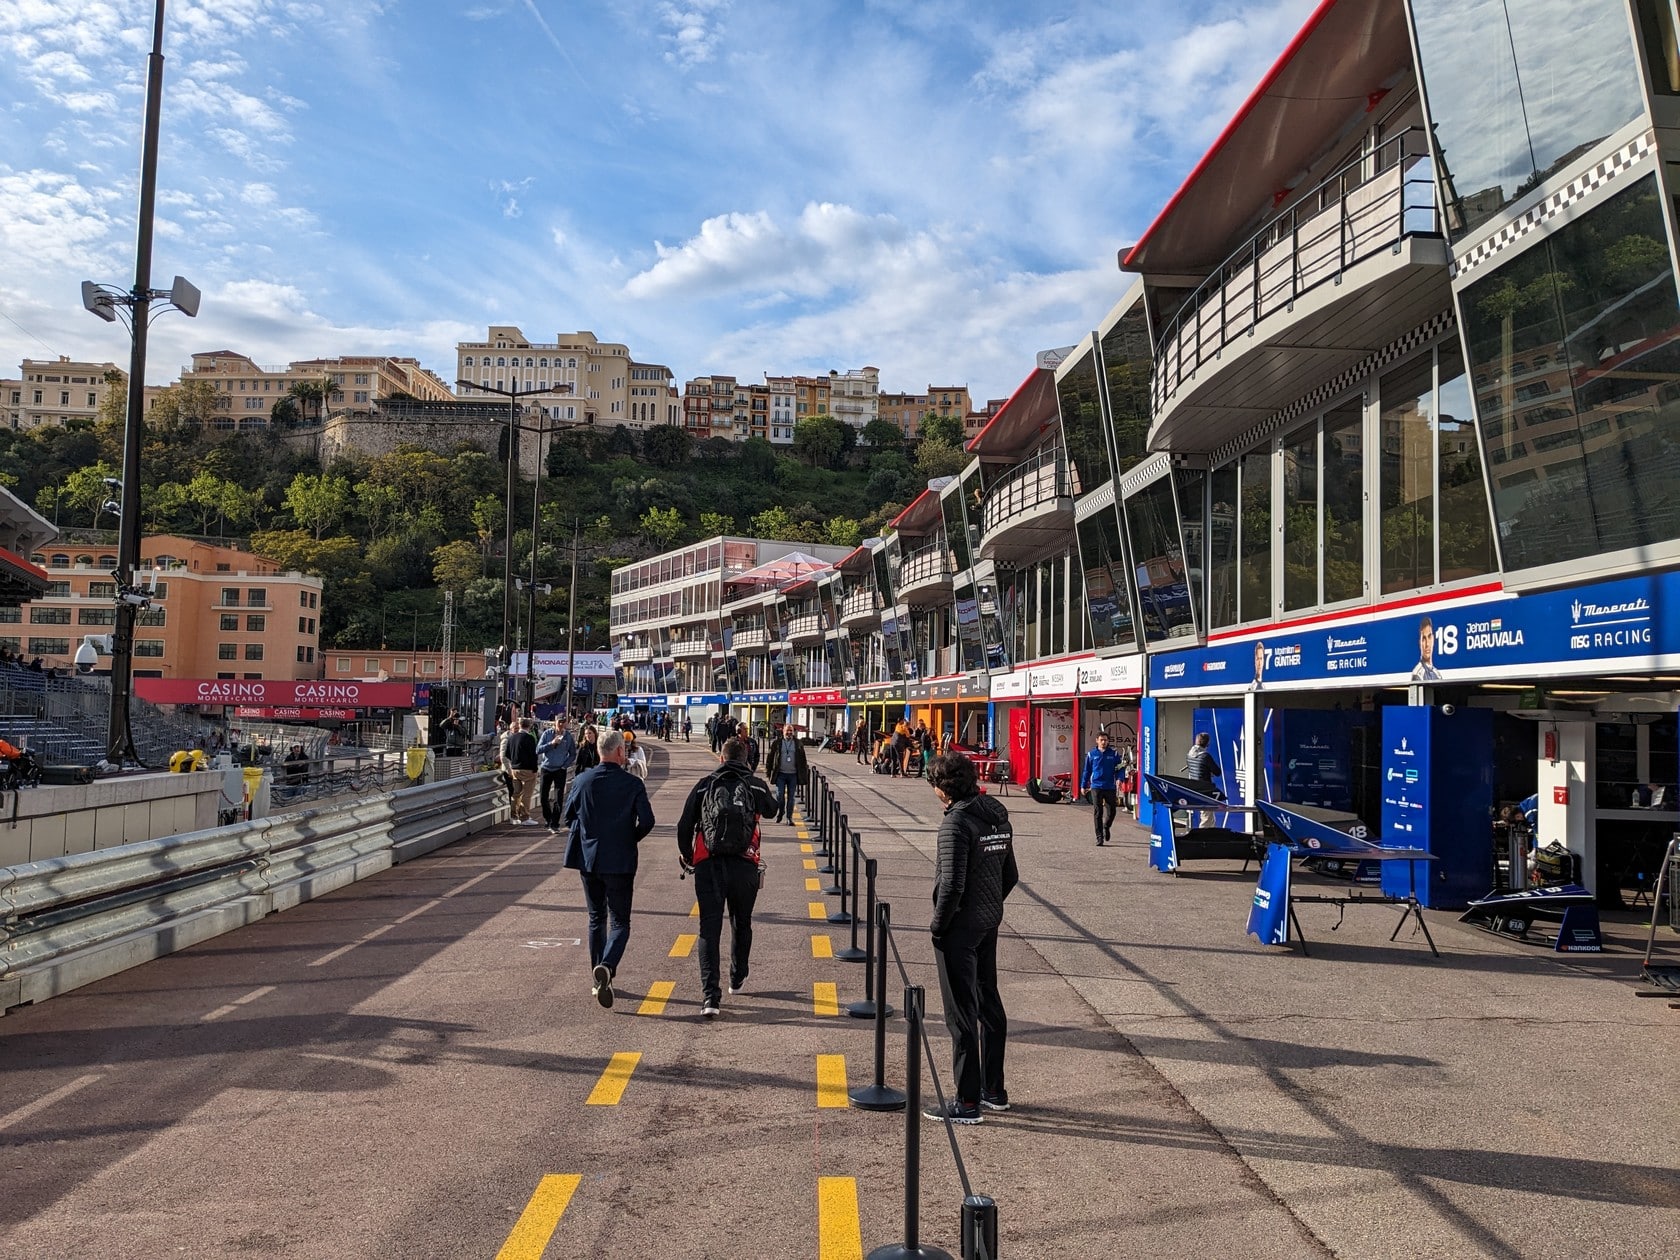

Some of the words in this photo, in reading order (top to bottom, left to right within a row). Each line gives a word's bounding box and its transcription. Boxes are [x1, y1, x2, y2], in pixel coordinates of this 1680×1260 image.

[1583, 598, 1650, 617] Maserati
[1466, 622, 1490, 634] Jehan
[1435, 624, 1458, 655] 18
[1466, 630, 1524, 650] DARUVALA
[1570, 634, 1590, 649] MSG
[1595, 628, 1651, 647] RACING
[1265, 648, 1273, 670] 7
[1339, 657, 1367, 669] RACING
[1081, 671, 1089, 684] 22
[1110, 665, 1128, 676] NISSAN
[198, 683, 265, 696] CASINO
[294, 685, 359, 698] CASINO
[1212, 791, 1221, 801] 7
[1349, 825, 1367, 838] 18
[1328, 861, 1340, 870] FIA
[1510, 920, 1523, 930] FIA
